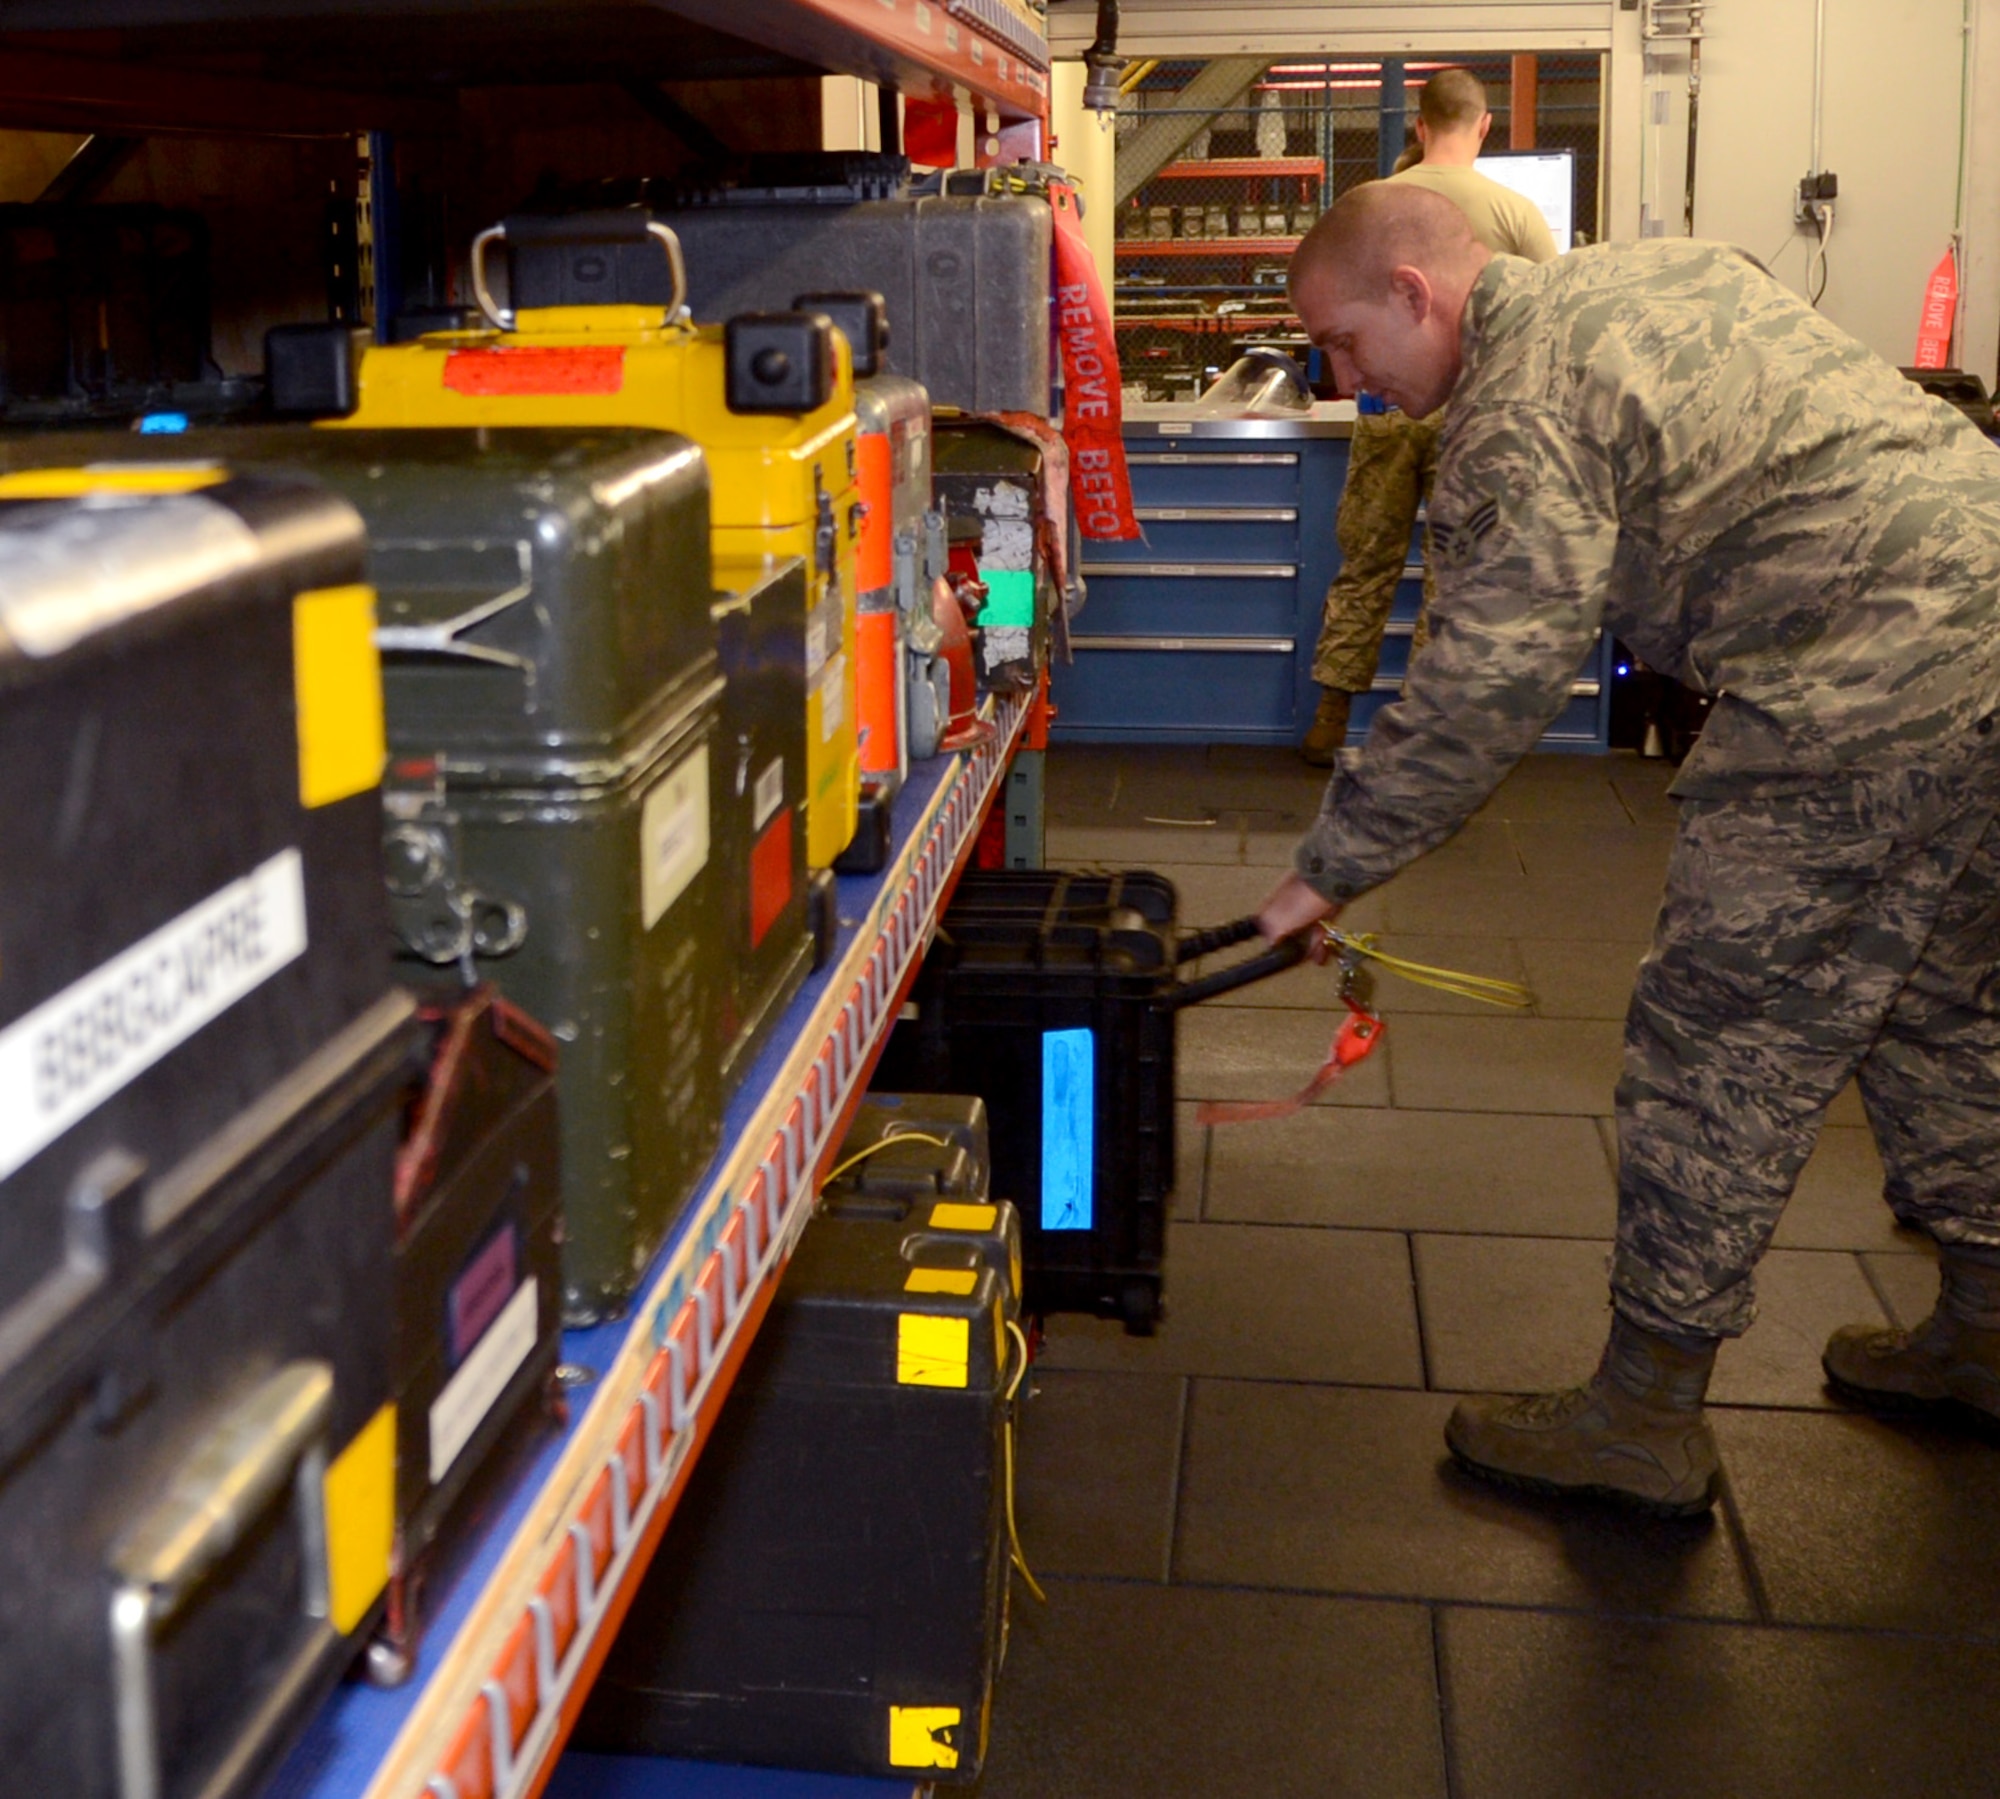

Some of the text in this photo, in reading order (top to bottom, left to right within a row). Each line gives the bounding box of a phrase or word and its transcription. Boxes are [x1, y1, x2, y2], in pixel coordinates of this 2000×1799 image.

[1926, 276, 1951, 329] REMOVE
[1058, 282, 1124, 541] REMOVE BEFO
